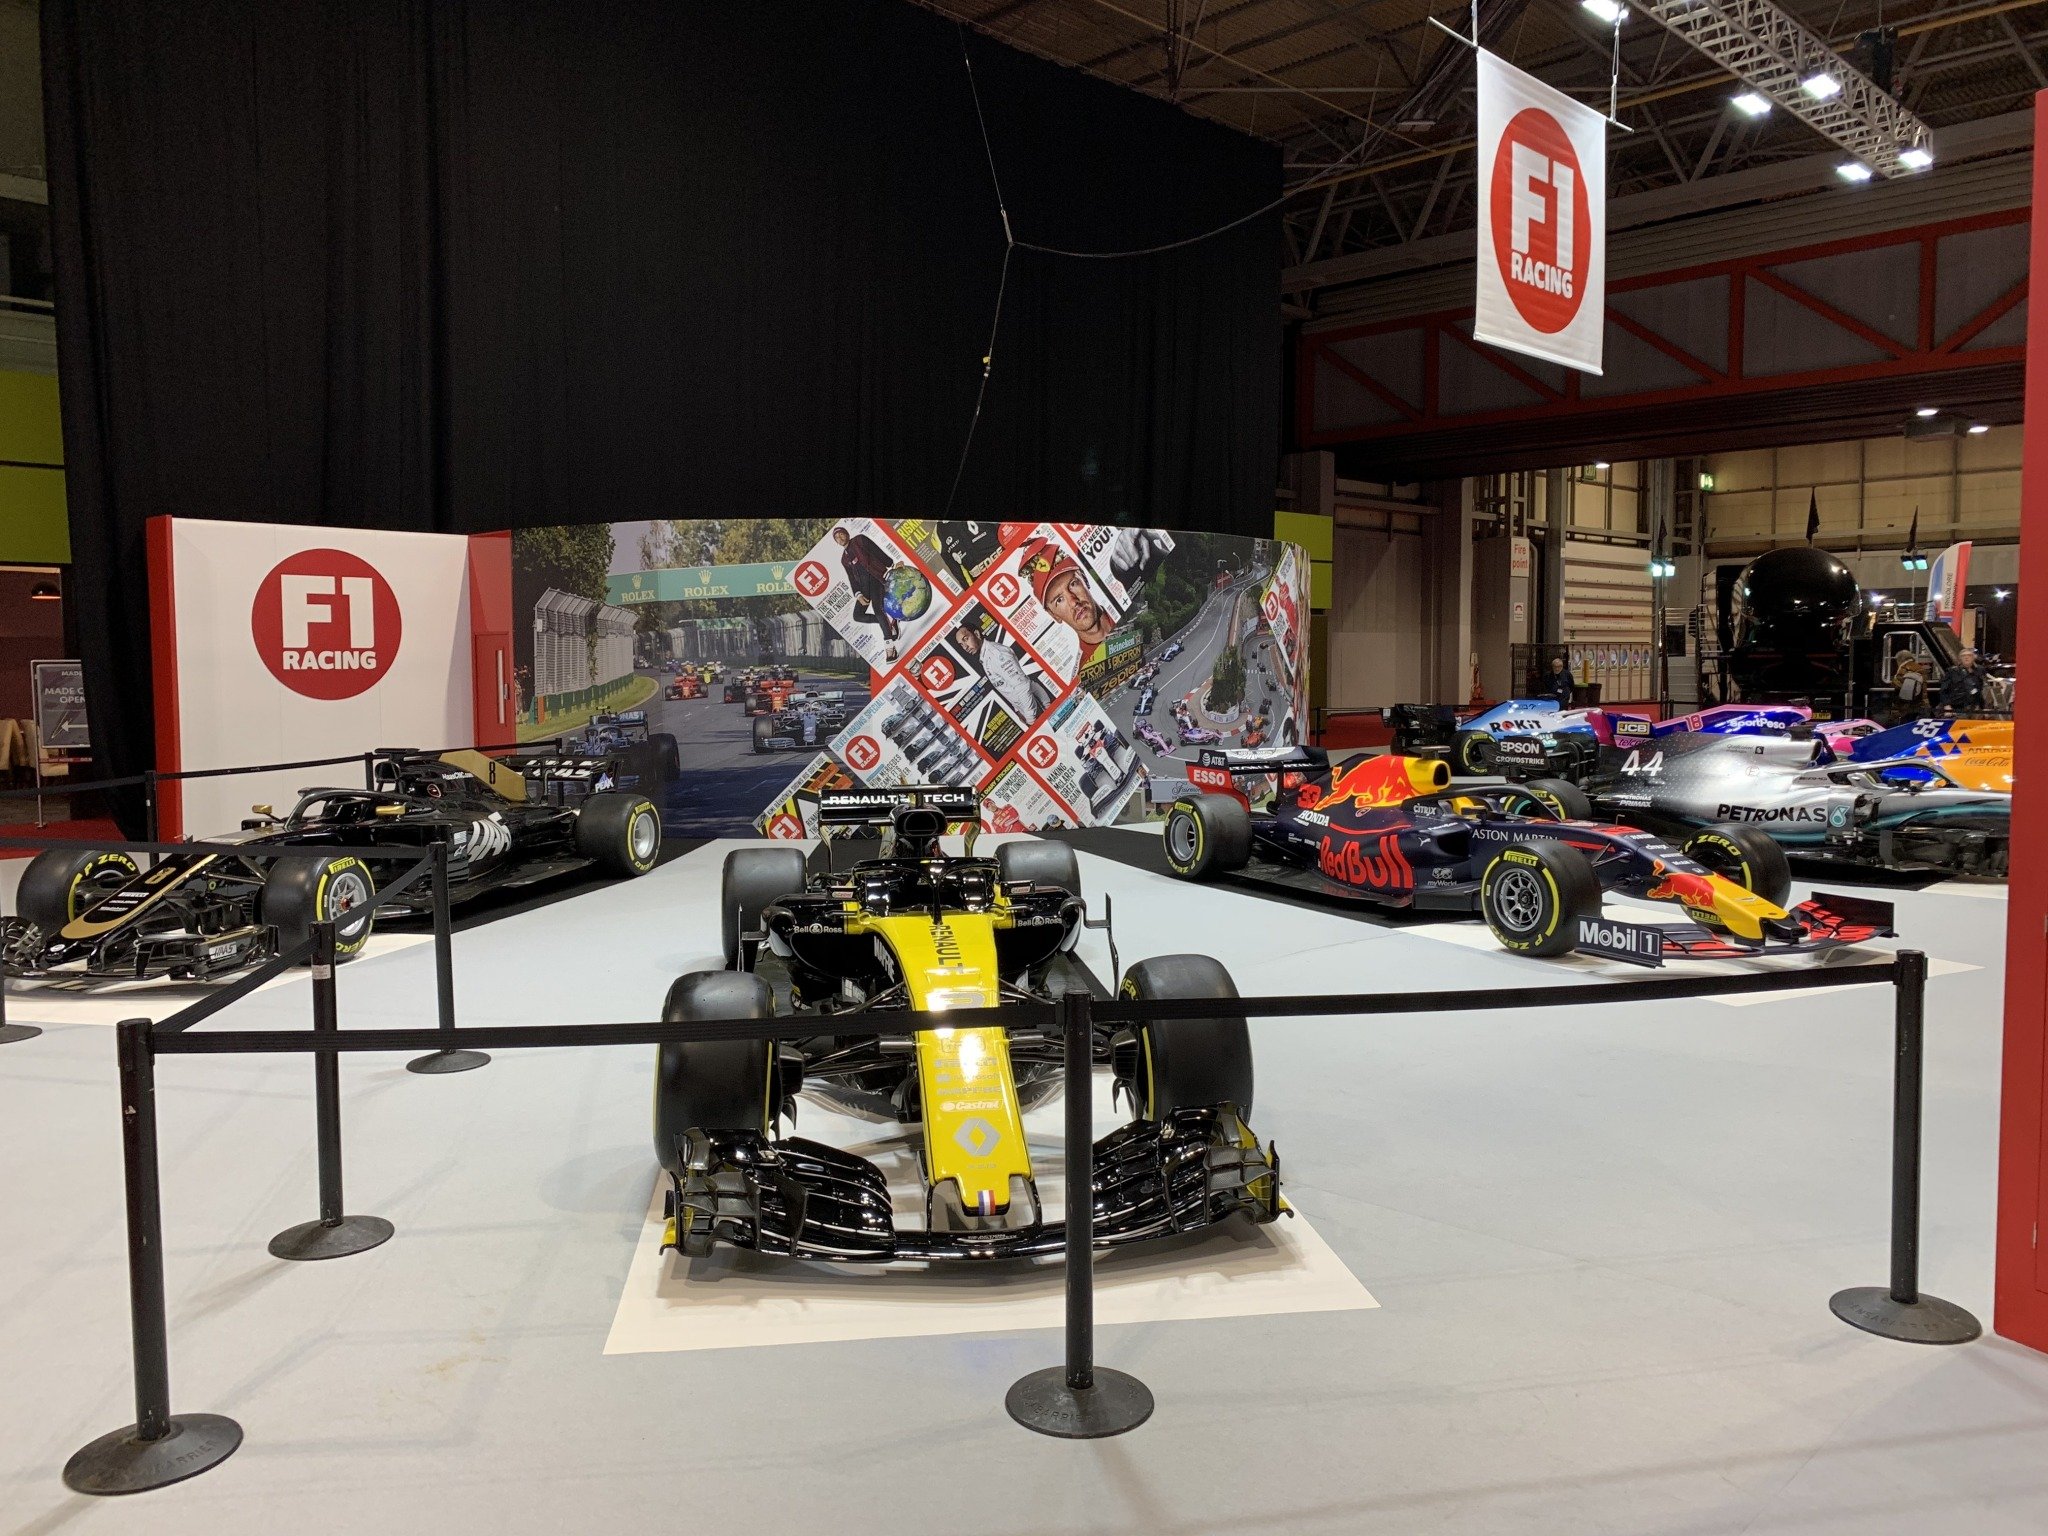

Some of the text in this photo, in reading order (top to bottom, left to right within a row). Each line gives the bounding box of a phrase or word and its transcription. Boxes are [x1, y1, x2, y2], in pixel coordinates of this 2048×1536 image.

[1511, 140, 1574, 271] F1
[1511, 251, 1573, 299] RACING
[911, 524, 930, 543] ALL
[1084, 527, 1112, 560] YOU!
[1080, 542, 1090, 552] F1
[1514, 544, 1527, 554] Fire
[1512, 560, 1528, 569] point
[796, 563, 824, 591] F1
[621, 589, 656, 603] ROLEX
[684, 585, 730, 598] ROLEX
[988, 574, 1015, 602] F1
[817, 602, 830, 615] THE
[825, 586, 845, 607] WORLD
[839, 582, 849, 592] IS
[823, 607, 837, 622] NOT
[831, 590, 853, 613] ENOUGH
[281, 574, 375, 649] F1
[1009, 596, 1037, 627] UNRAVELLING
[1015, 608, 1038, 633] SEBASTIAN
[1021, 620, 1038, 639] VETTEL
[1105, 633, 1137, 655] Heineken
[282, 650, 377, 670] RACING
[922, 658, 949, 685] F1
[934, 670, 952, 689] RACING
[1101, 658, 1142, 695] zepter
[44, 687, 75, 696] MADE
[832, 694, 886, 752] SILVER ARROWS SPECIAL!
[1619, 723, 1648, 733] JCB
[1685, 714, 1704, 733] 18
[1729, 718, 1786, 730] SportPesa
[1912, 718, 1944, 738] 55
[847, 737, 875, 765] F1
[1027, 735, 1055, 764] F1
[1039, 747, 1057, 768] RACING
[1500, 741, 1540, 755] EPSON
[806, 762, 818, 775] SOFT
[859, 749, 878, 769] RACING
[877, 752, 902, 778] MERCEDES
[1211, 756, 1226, 767] AT&T
[1495, 755, 1545, 766] CROWDSTRIKE
[1620, 750, 1665, 777] 44
[488, 761, 496, 785] 8
[983, 779, 998, 795] DIARY
[994, 759, 1016, 782] STICKERS
[993, 766, 1024, 799] SCHUMACHER
[1045, 761, 1067, 785] MAKING
[1052, 764, 1077, 792] McLAREN
[1193, 769, 1225, 786] ESSO
[594, 777, 615, 794] PEAK
[1001, 772, 1030, 803] OR ALONSO?
[1059, 778, 1078, 799] GREAT
[829, 795, 899, 806] RENAULT
[1065, 787, 1083, 806] AGAIN
[1619, 800, 1652, 808] PRIMAX
[1298, 810, 1330, 827] HONDA
[1716, 803, 1827, 823] PETRONAS
[770, 815, 799, 839] F1
[1472, 829, 1509, 842] ASTON
[1696, 834, 1741, 857] ZERO
[84, 853, 137, 876] P ZERO
[328, 856, 356, 875] PIRELLI
[1503, 851, 1538, 866] PIRELLI
[144, 866, 177, 885] 8
[794, 922, 843, 935] Bell & Ross
[1017, 915, 1063, 927] Bell & Ross
[1579, 920, 1637, 952] Mobil
[213, 944, 235, 958] HAAS
[929, 924, 964, 974] RENAULT
[1120, 977, 1139, 1001] ZER
[955, 1100, 1000, 1111] Castrol
